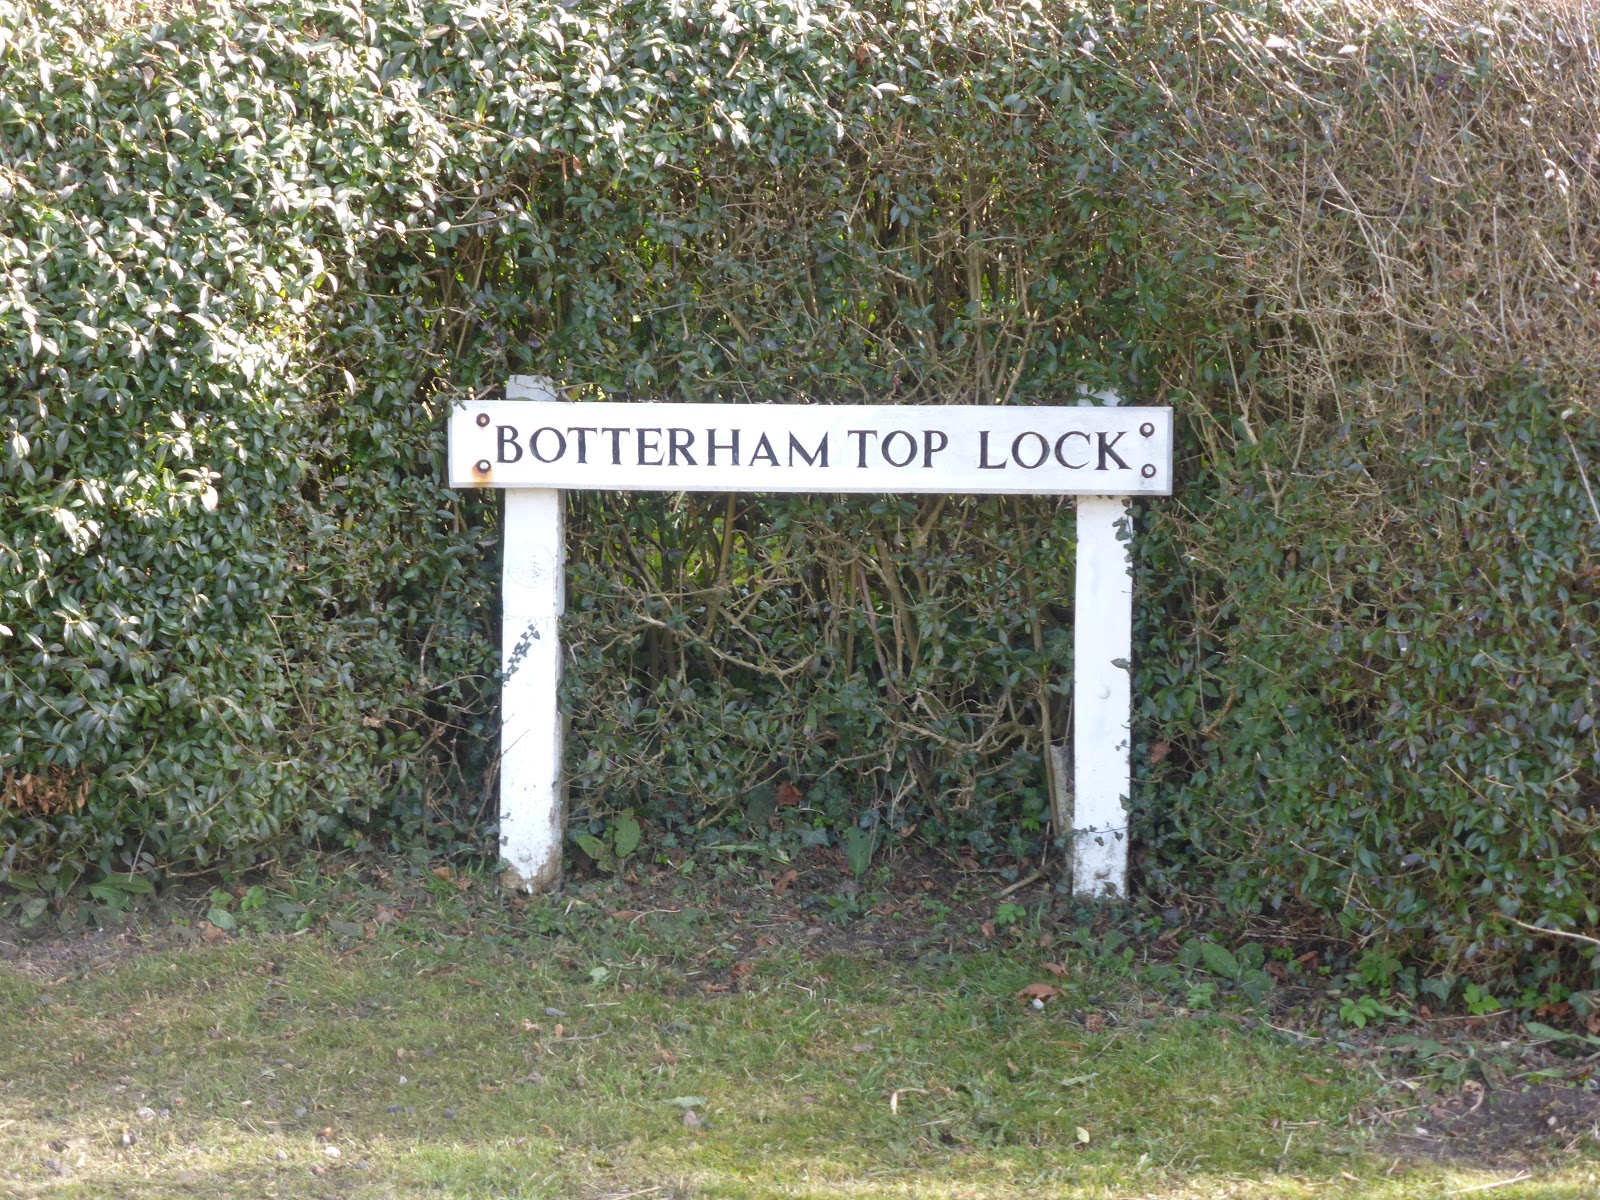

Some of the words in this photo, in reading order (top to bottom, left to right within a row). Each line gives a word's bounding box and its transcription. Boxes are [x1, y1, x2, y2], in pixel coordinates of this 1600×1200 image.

[497, 425, 829, 469] BOTTERHAM
[847, 430, 948, 468] TOP
[978, 430, 1132, 471] LOCK
